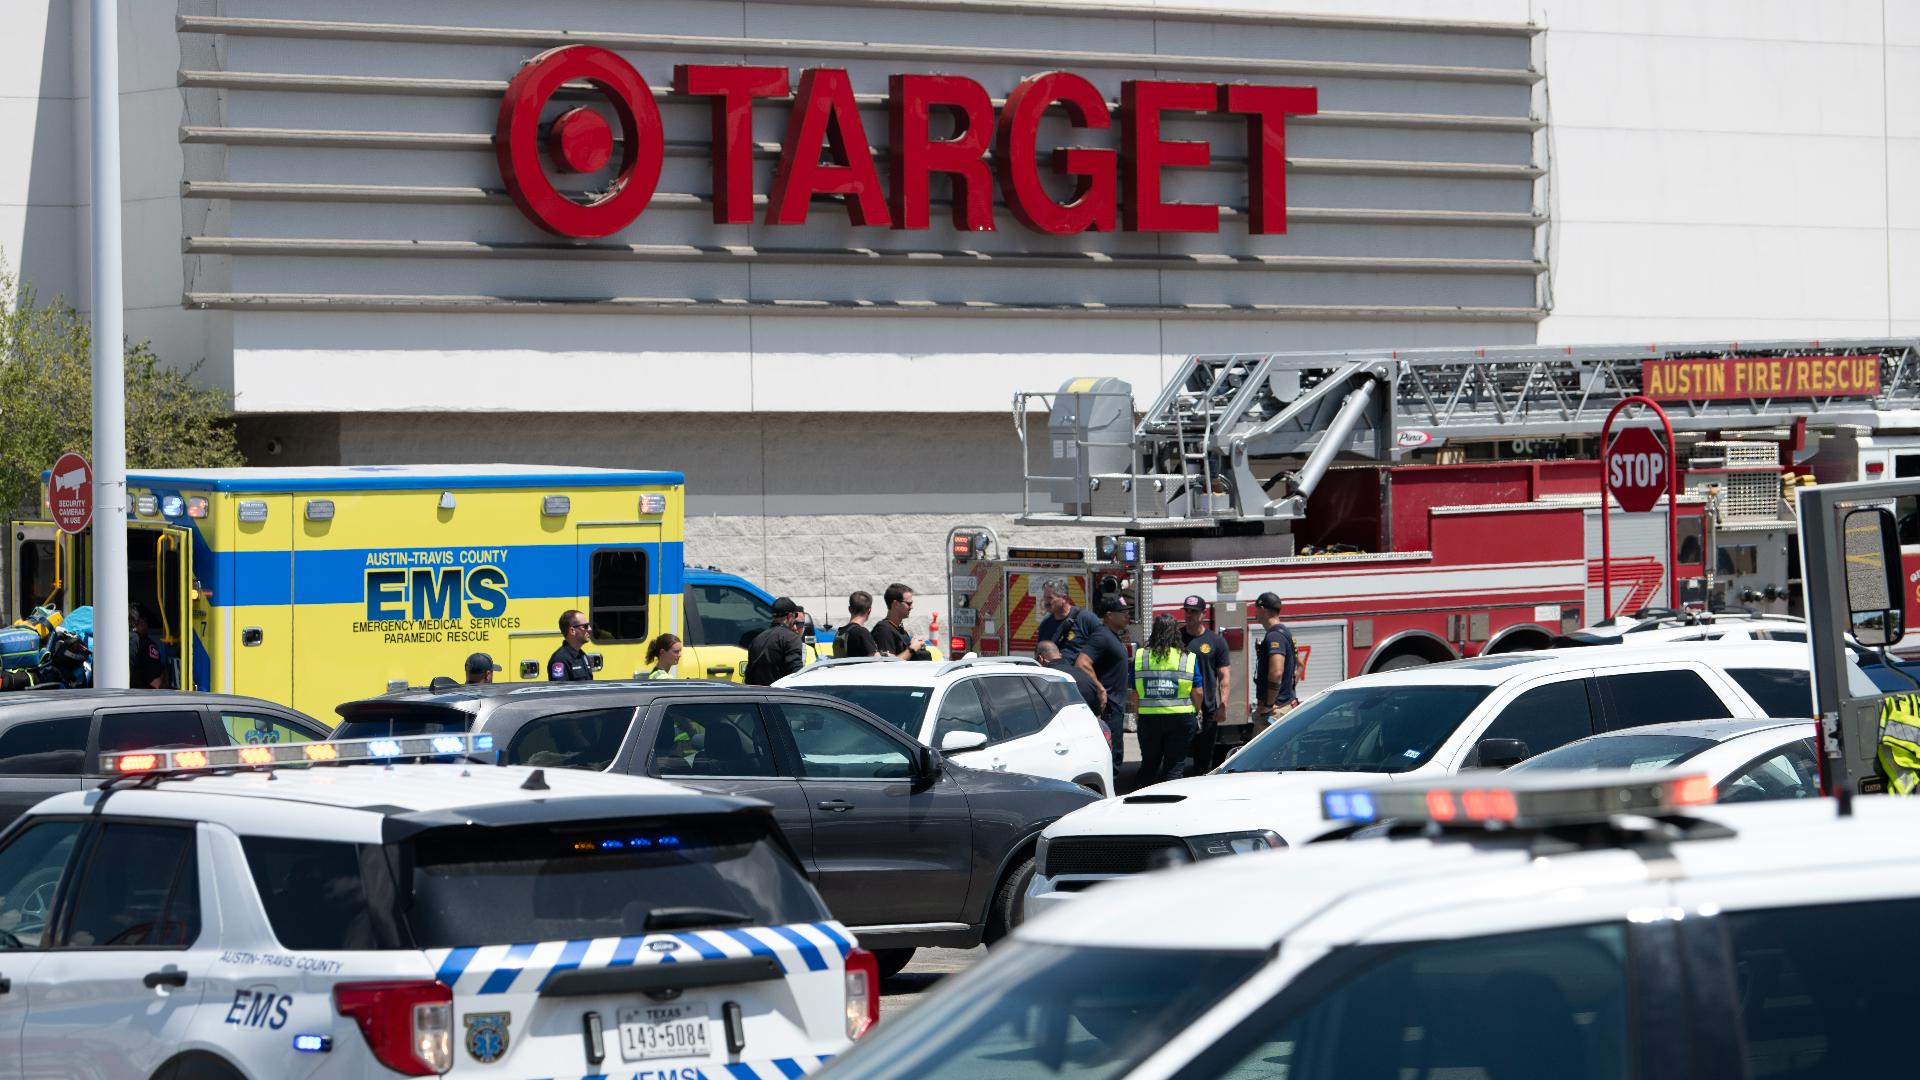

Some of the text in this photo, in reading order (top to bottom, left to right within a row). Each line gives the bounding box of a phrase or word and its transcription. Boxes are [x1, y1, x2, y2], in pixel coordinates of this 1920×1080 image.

[674, 64, 1318, 235] TARGET
[1650, 358, 1876, 394] AUSTIN FIRE/RESCUE
[1610, 452, 1663, 488] STOP
[58, 499, 85, 507] SECURITY
[58, 508, 86, 516] CAMERAS
[70, 516, 81, 524] USE
[366, 549, 508, 566] AUSTIN-TRAVIS COUNTY
[365, 566, 508, 621] EMS
[352, 617, 521, 632] EMERGENCY MEDICAL SERVICES
[384, 630, 489, 644] PARAMEDIC RESCUE
[220, 951, 343, 974] AUSTIN-TRAVIS COUNTY
[225, 989, 293, 1030] EMS
[646, 1008, 681, 1019] TEXAS
